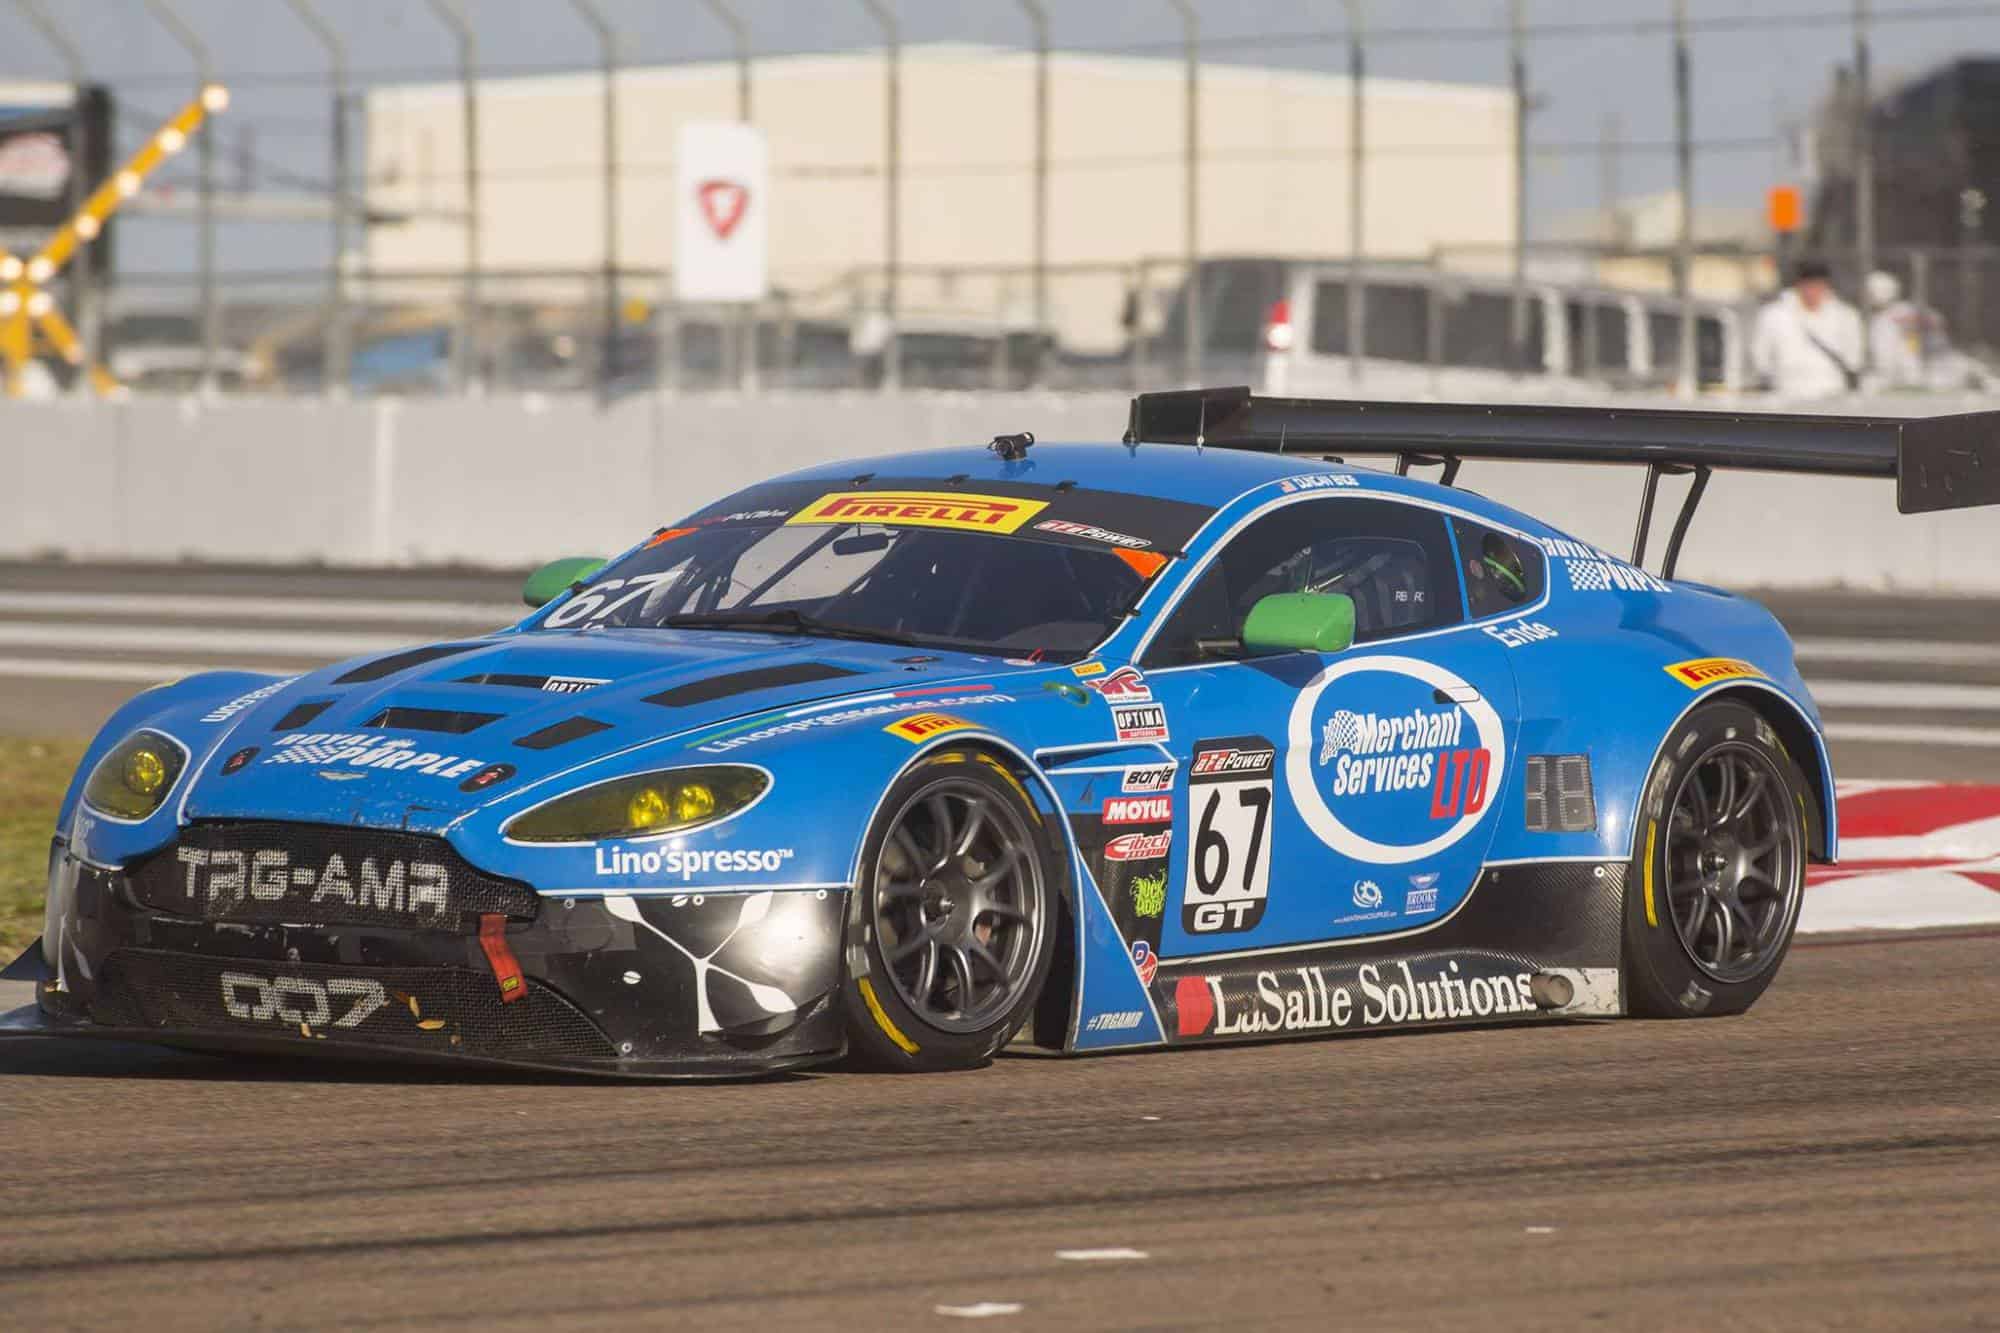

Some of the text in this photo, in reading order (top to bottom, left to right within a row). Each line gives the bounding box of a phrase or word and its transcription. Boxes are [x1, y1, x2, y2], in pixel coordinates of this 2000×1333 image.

[815, 497, 1019, 525] PIRELLI
[544, 557, 692, 628] 67
[1482, 619, 1558, 648] Ende
[1117, 711, 1163, 729] OPTIMA
[1354, 707, 1462, 756] Merchant
[271, 733, 387, 747] ROYAL
[324, 745, 485, 779] PURPLE
[1333, 748, 1492, 820] Services LTD
[1107, 798, 1170, 821] MOTUL
[1194, 787, 1272, 896] 67
[1194, 901, 1255, 932] GT
[1208, 958, 1537, 1035] LaSalle Solutions
